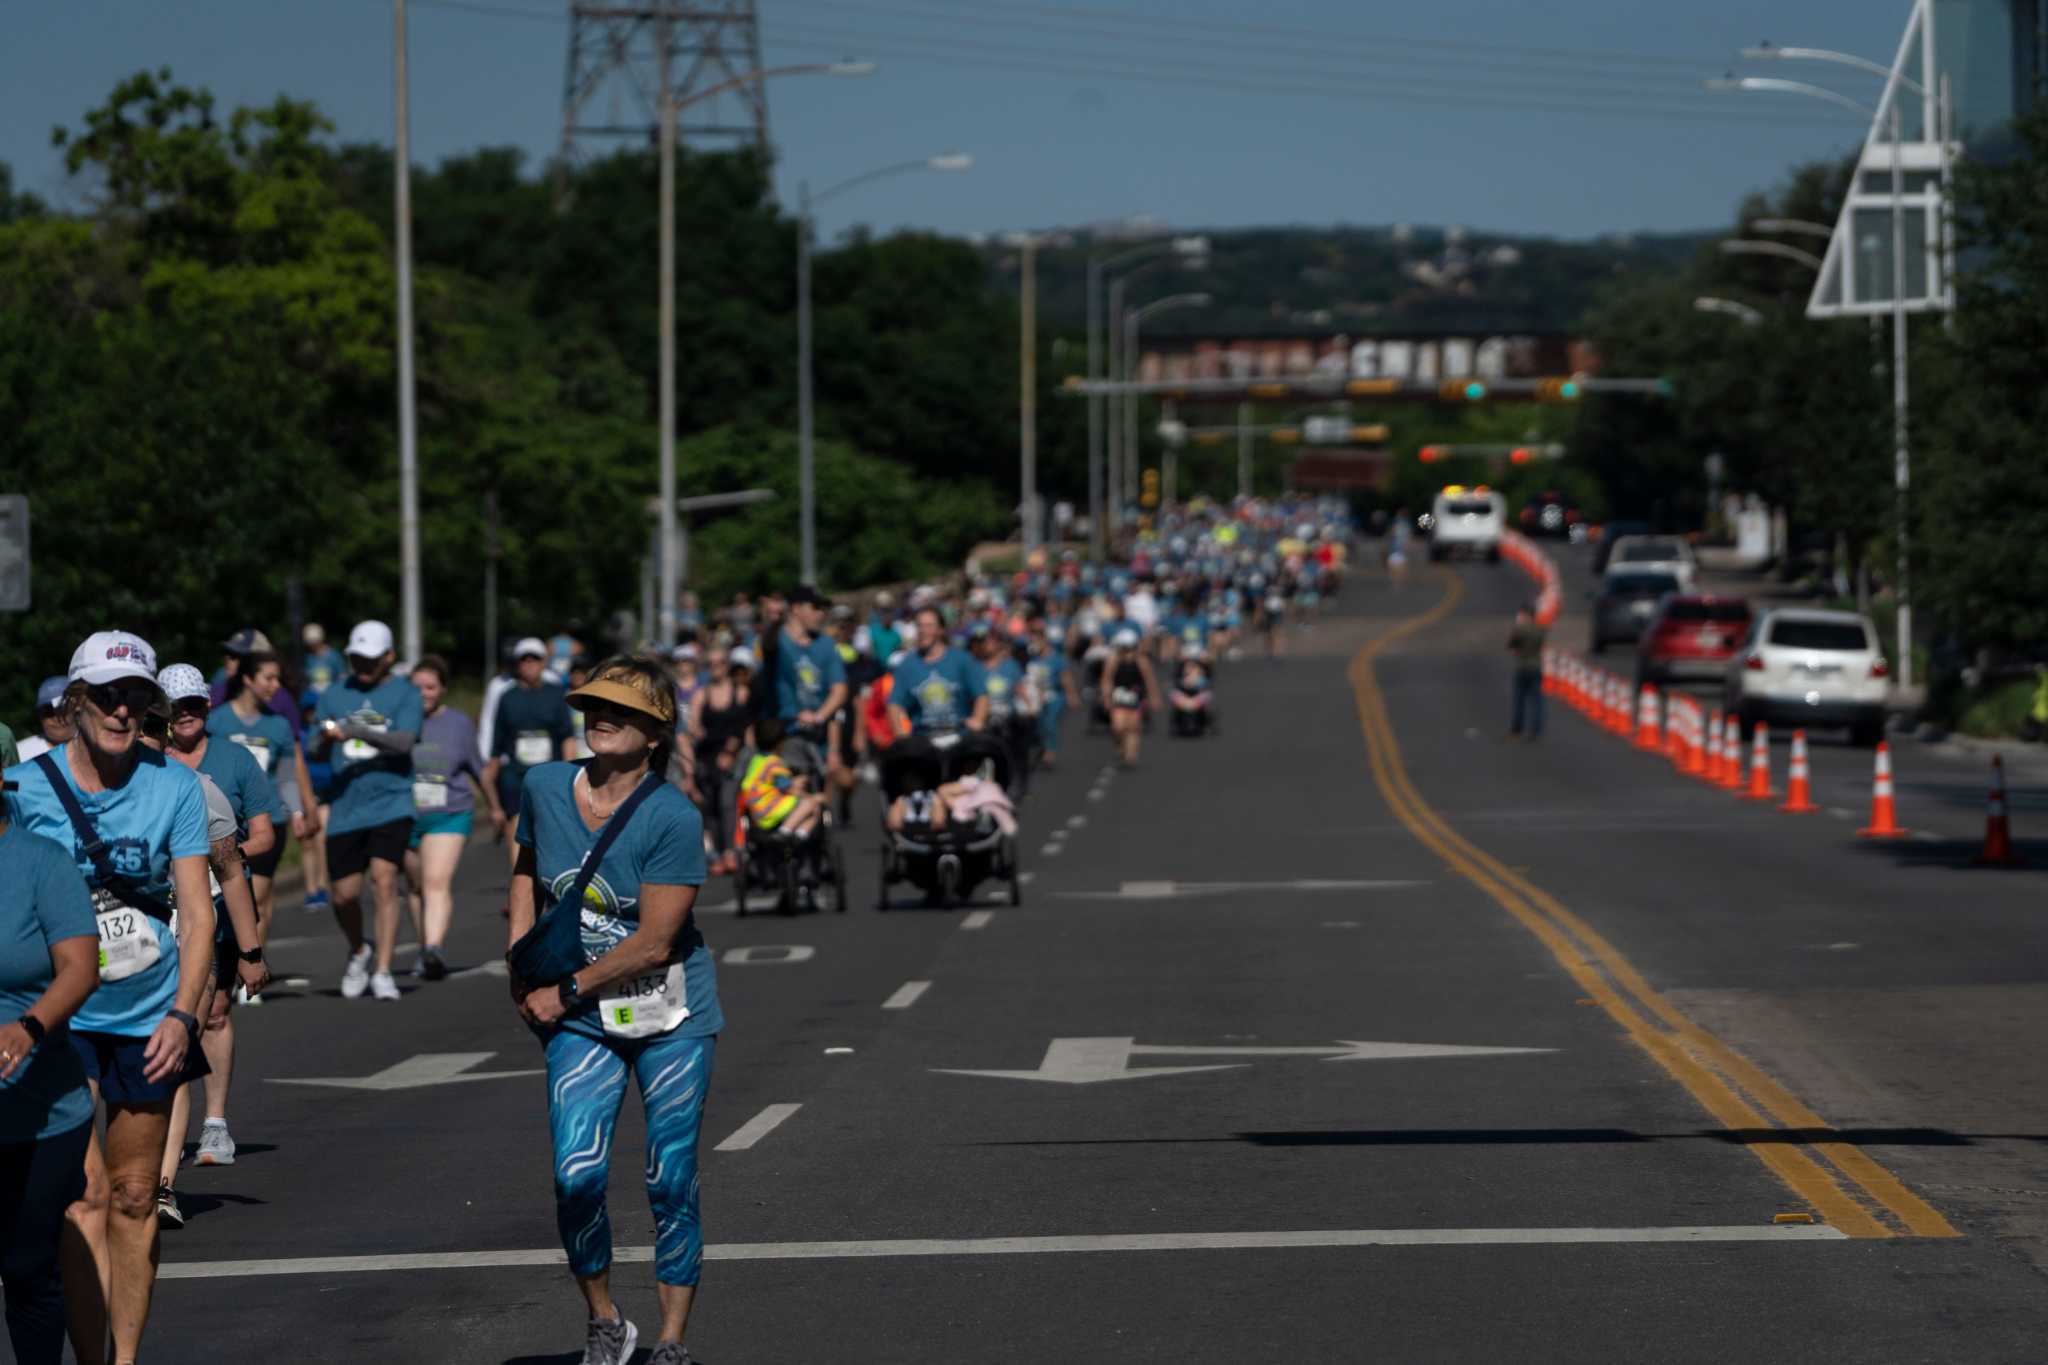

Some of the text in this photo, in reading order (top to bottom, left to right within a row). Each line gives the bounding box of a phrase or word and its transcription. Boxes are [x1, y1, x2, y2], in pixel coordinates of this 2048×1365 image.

[97, 914, 136, 941] 132
[618, 974, 668, 998] 4133
[619, 1008, 630, 1024] E
